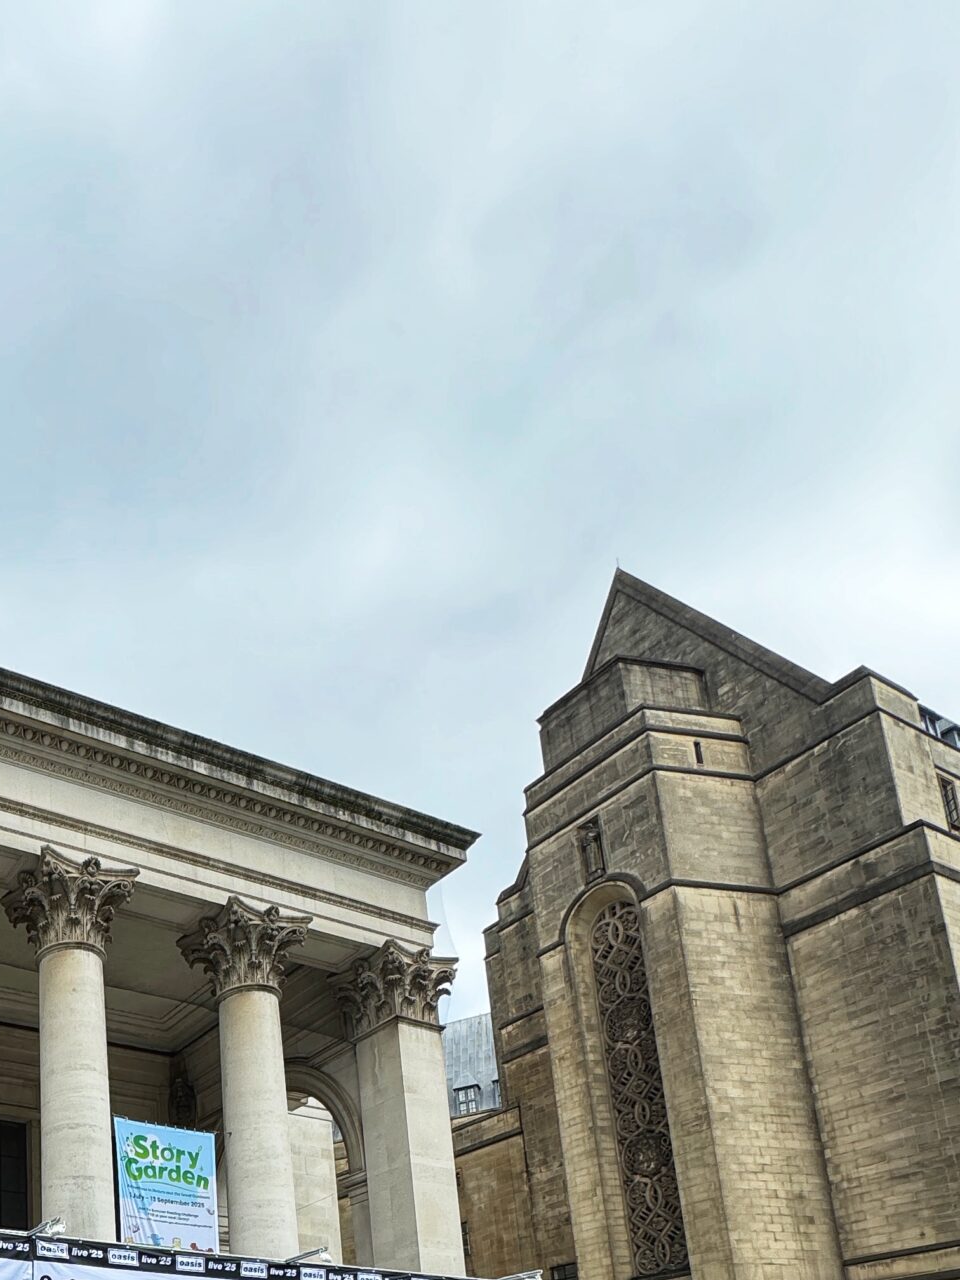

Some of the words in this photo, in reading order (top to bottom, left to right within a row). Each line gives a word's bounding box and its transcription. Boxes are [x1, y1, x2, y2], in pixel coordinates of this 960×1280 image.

[133, 1135, 200, 1169] Story
[125, 1157, 209, 1190] Garden
[133, 1193, 144, 1201] July
[157, 1197, 189, 1206] September
[40, 1245, 65, 1255] oasis
[71, 1248, 88, 1257] live
[111, 1252, 136, 1262] oasis
[141, 1255, 157, 1264] live
[179, 1260, 202, 1269] oasis
[208, 1262, 222, 1271] live
[243, 1265, 265, 1274] oasis
[270, 1268, 284, 1276] live
[303, 1272, 324, 1280] oasis
[329, 1273, 342, 1280] live
